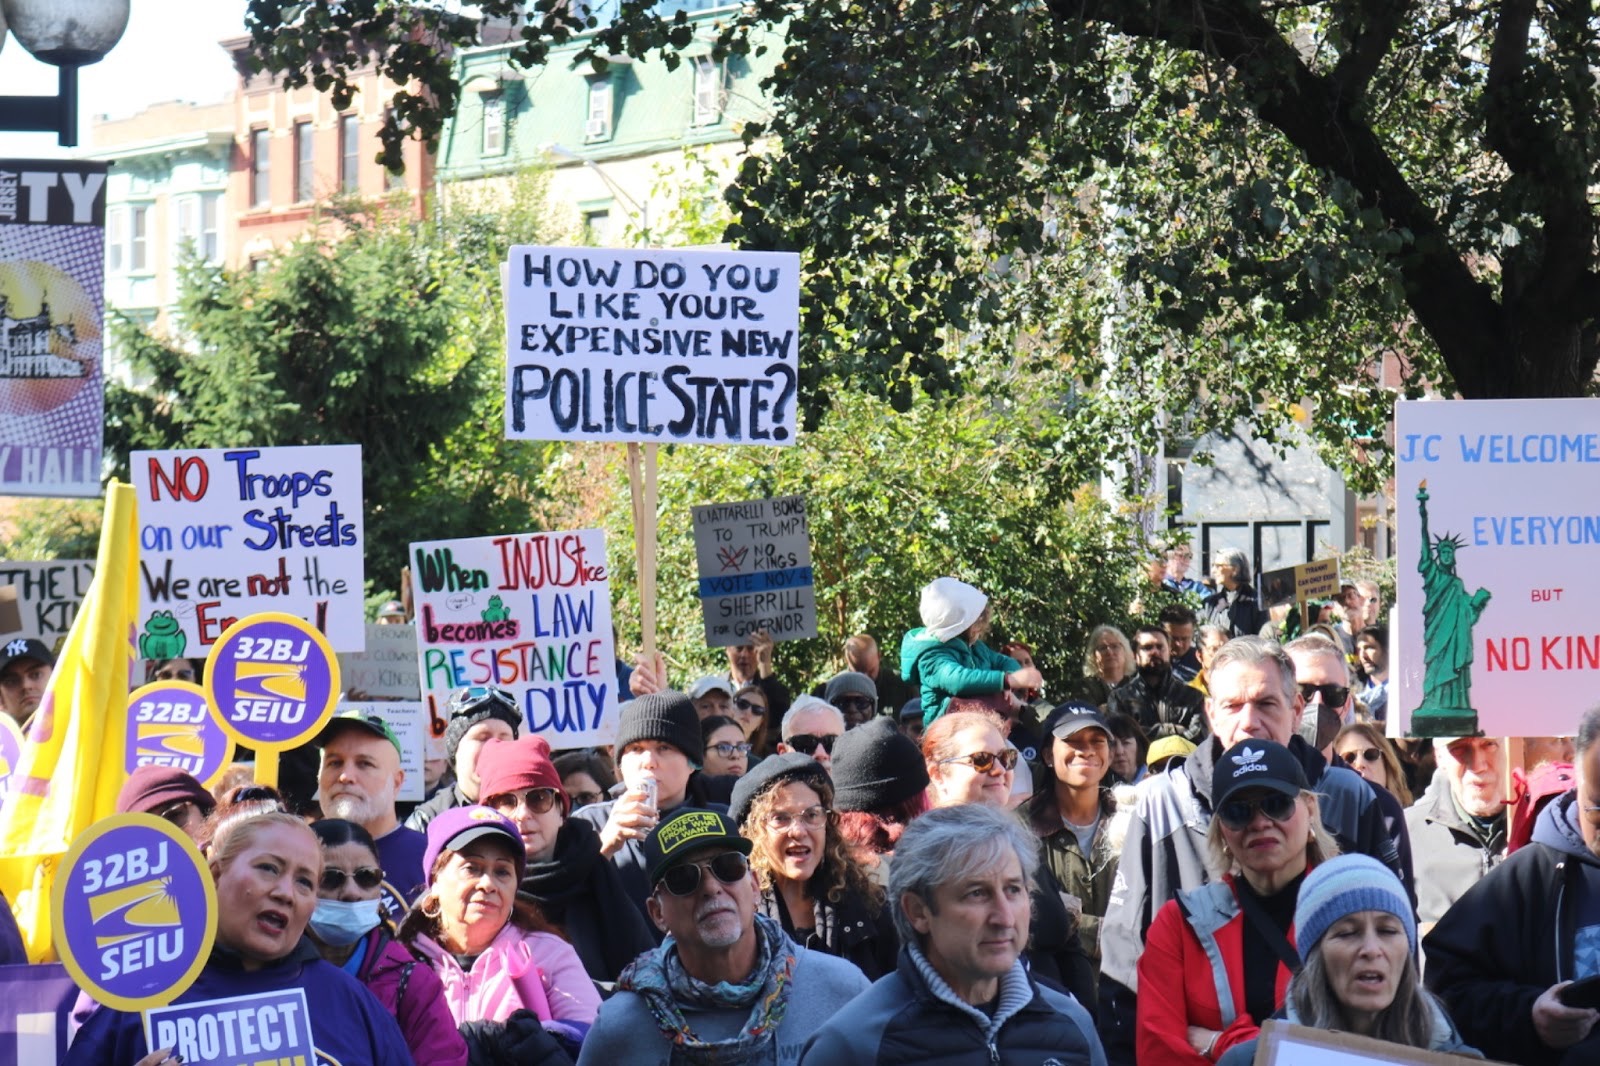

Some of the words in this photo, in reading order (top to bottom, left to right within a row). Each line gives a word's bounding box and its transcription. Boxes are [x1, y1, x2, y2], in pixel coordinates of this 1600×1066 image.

[524, 254, 622, 288] HOW
[632, 260, 687, 290] DO
[702, 263, 781, 293] YOU
[549, 291, 641, 321] LIKE
[658, 291, 765, 321] YOUR
[520, 323, 712, 357] EXPENSIVE
[721, 329, 793, 359] NEW
[511, 364, 665, 437] POLICE
[662, 362, 797, 441] STATE?
[1400, 434, 1442, 462] JC
[1459, 433, 1600, 464] WELCOME
[21, 447, 99, 485] HALL
[148, 456, 209, 502] NO
[224, 450, 333, 508] Troops
[141, 525, 173, 552] on
[181, 525, 233, 550] our
[243, 501, 357, 551] Streets
[698, 502, 764, 525] CIATTARELLI
[773, 498, 804, 517] BOWS
[713, 527, 733, 542] TO
[746, 517, 806, 539] TRUMP!
[1473, 515, 1600, 546] EVERYON
[753, 543, 775, 557] NO
[753, 552, 797, 571] KINGS
[0, 566, 66, 601] THE
[140, 559, 190, 602] We
[197, 577, 242, 599] are
[247, 557, 292, 596] not
[303, 556, 348, 596] the
[415, 547, 489, 593] When
[709, 574, 753, 593] VOTE
[765, 570, 795, 588] NOV
[799, 571, 808, 583] 4
[719, 590, 805, 617] SHERRILL
[1531, 588, 1564, 602] BUT
[424, 603, 517, 644] becomes
[532, 590, 594, 639] LAW
[233, 636, 311, 662] 32BJ
[425, 640, 602, 689] RESISTANCE
[1486, 637, 1530, 671] NO
[1541, 635, 1600, 671] KIN
[135, 701, 208, 723] 32BJ
[230, 700, 306, 724] SEIU
[525, 681, 607, 733] DUTY
[1233, 763, 1268, 778] adidas
[661, 815, 699, 838] PROTECT
[664, 825, 688, 843] FROM
[681, 826, 709, 838] WANT
[82, 841, 168, 894] 32BJ
[100, 927, 184, 981] SEIU
[157, 1002, 299, 1064] PROTECT
